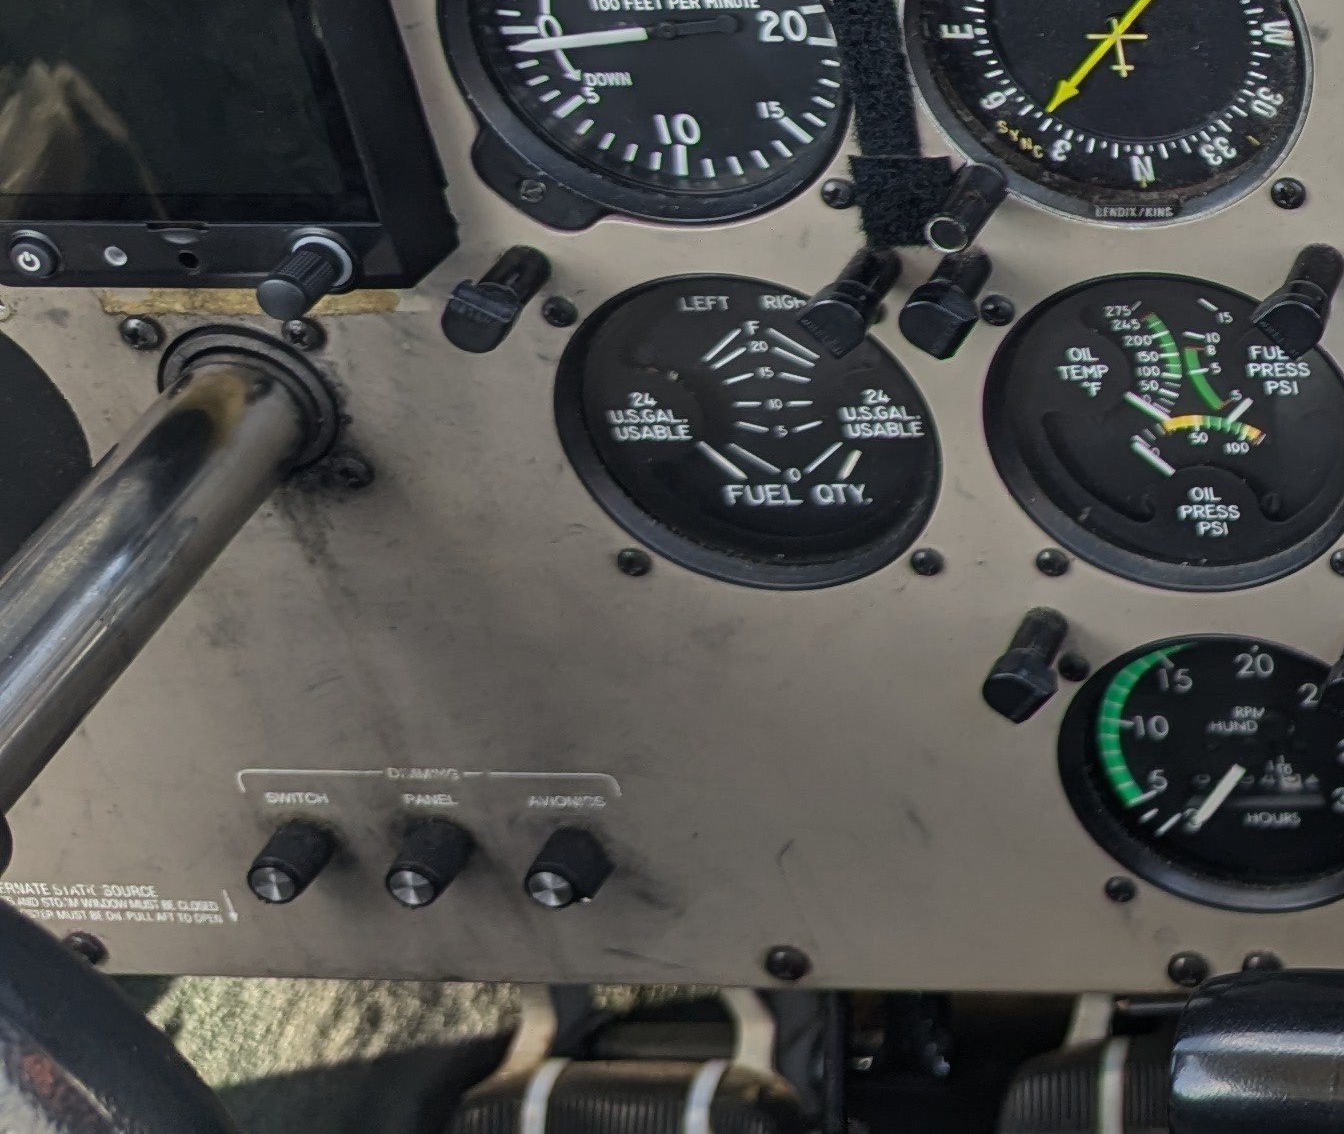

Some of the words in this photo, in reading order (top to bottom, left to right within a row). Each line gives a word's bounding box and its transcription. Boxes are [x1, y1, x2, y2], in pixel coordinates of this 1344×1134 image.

[756, 9, 808, 43] 20
[583, 72, 633, 87] DOWN
[678, 295, 730, 312] LEFT
[722, 484, 804, 507] FUEL
[812, 483, 873, 507] QTY.
[1187, 486, 1223, 502] OIL
[1177, 504, 1241, 521] PRESS
[1196, 520, 1230, 537] PSI
[1234, 652, 1275, 678] 20
[102, 885, 158, 898] SOURCE
